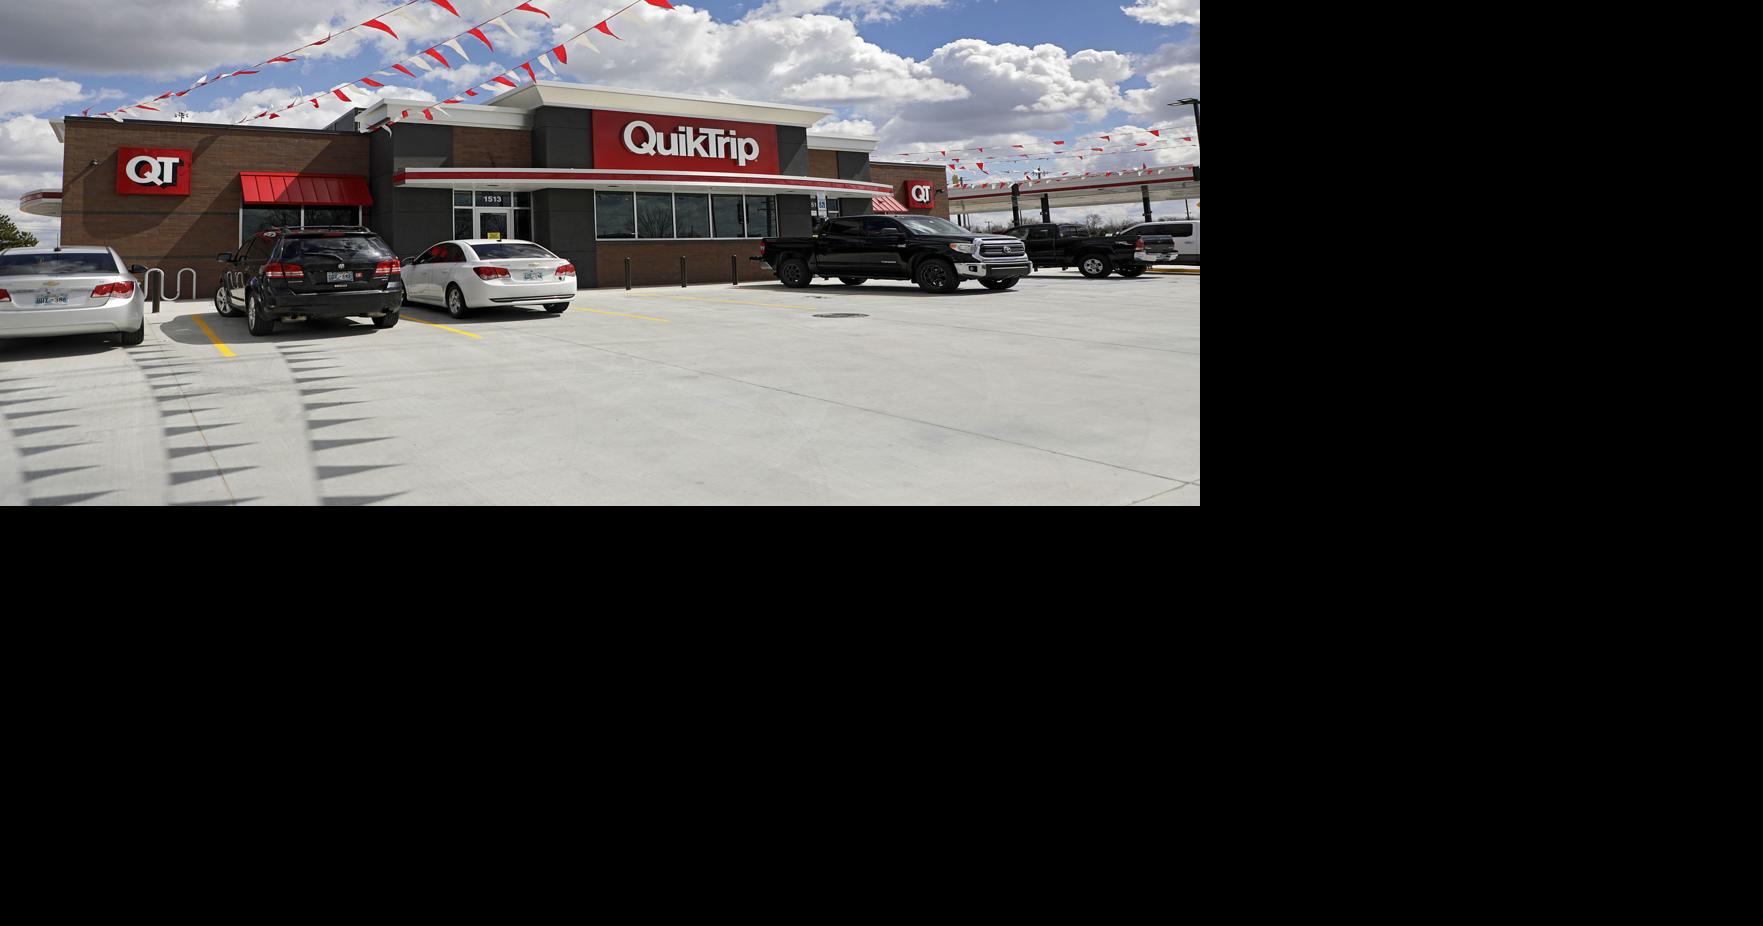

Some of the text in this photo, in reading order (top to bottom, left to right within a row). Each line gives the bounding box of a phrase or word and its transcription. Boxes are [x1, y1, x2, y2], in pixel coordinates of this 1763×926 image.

[623, 120, 760, 167] QuikTrip
[125, 155, 180, 186] QT
[483, 195, 502, 203] 1513
[911, 184, 931, 203] QT
